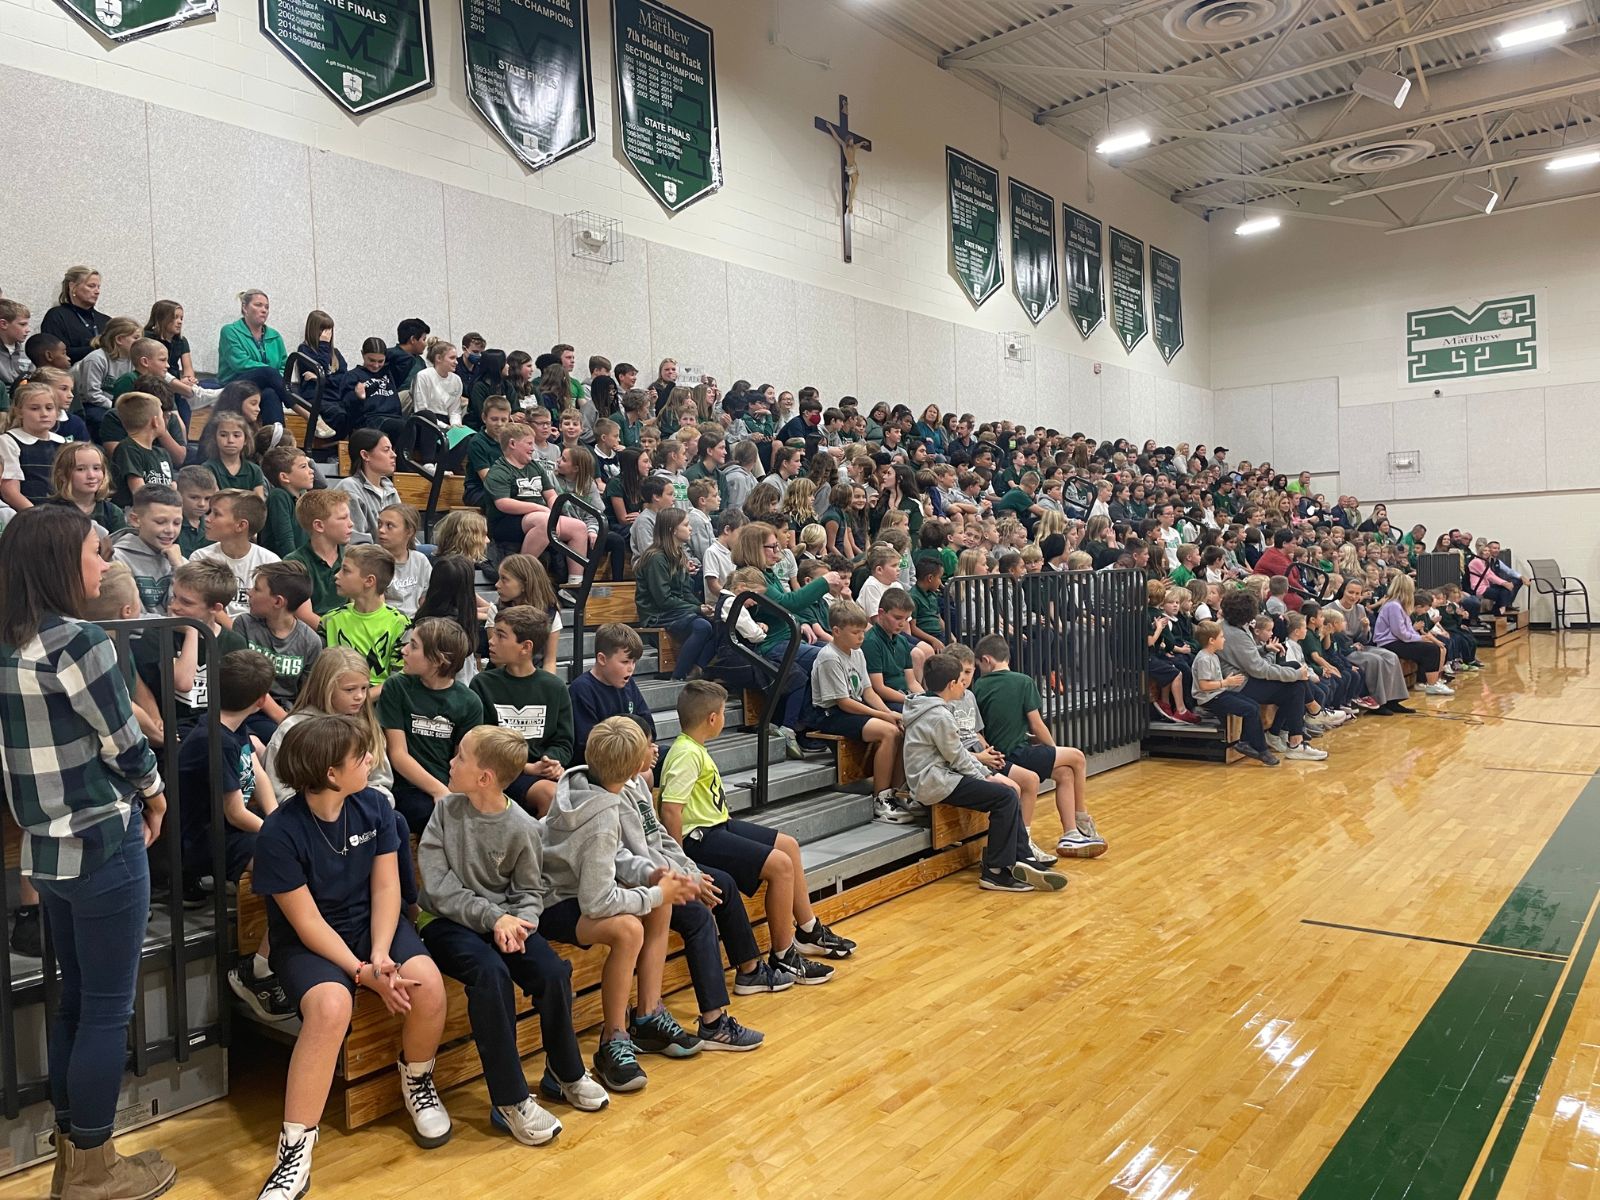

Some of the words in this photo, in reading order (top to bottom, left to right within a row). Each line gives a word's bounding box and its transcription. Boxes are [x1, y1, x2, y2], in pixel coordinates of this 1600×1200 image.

[348, 2, 387, 24] FINALS
[524, 0, 574, 28] CHAMPIONS
[638, 8, 690, 46] Matthew
[627, 27, 640, 43] 7th
[641, 33, 662, 53] Grade
[664, 44, 680, 61] Girls
[680, 52, 702, 71] Track
[498, 60, 527, 79] STATE
[625, 43, 665, 68] SECTIONAL
[665, 62, 704, 86] CHAMPIONS
[644, 117, 667, 133] STATE
[667, 125, 691, 142] FINALS
[1442, 333, 1502, 346] Matthew
[249, 643, 302, 675] RERS
